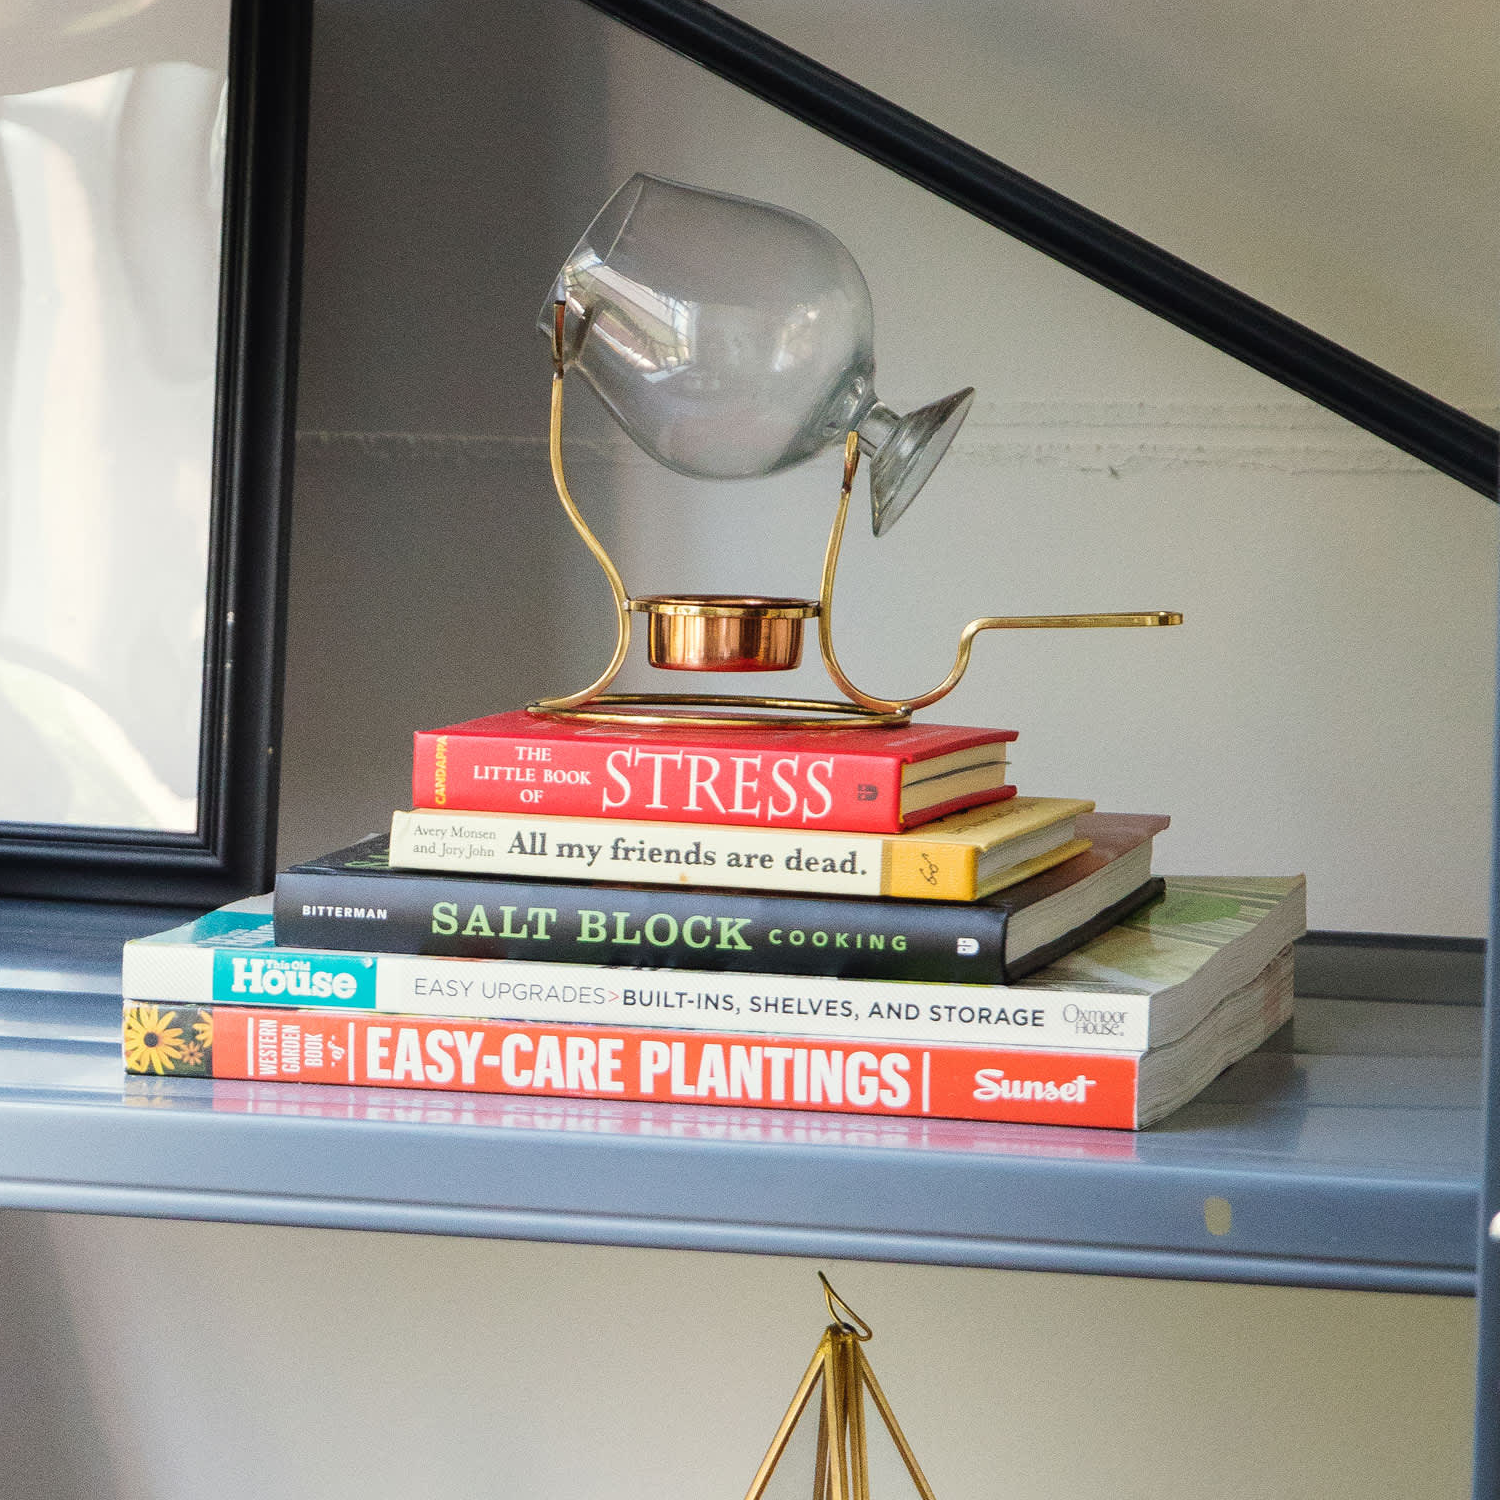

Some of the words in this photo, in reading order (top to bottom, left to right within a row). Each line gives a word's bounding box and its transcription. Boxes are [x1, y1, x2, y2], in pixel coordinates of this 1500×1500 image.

[434, 735, 448, 806] CANDAPPA
[515, 746, 552, 762] THE
[473, 765, 538, 783] LITTLE
[542, 768, 592, 786] BOOK
[519, 788, 544, 804] OF
[602, 746, 834, 823] STRESS
[412, 840, 436, 856] and
[439, 841, 465, 861] Jory
[468, 842, 496, 858] John
[414, 823, 447, 841] Avery
[450, 825, 497, 841] Monsen
[507, 831, 546, 857] All
[556, 840, 598, 867] my
[611, 836, 716, 868] friends
[726, 849, 775, 871] are
[785, 847, 868, 877] dead.
[302, 904, 388, 920] BITTERMAN
[432, 902, 558, 941] SALT
[578, 908, 753, 952] BLOCK
[768, 928, 909, 953] COOKING
[231, 958, 358, 1000] House
[266, 960, 290, 971] This
[291, 960, 312, 972] Old
[414, 977, 474, 997] EASY
[749, 995, 859, 1022] SHELVES,
[868, 1002, 921, 1023] AND
[929, 1004, 1046, 1028] STORAGE
[1062, 1003, 1128, 1024] Oxmoor
[259, 1019, 278, 1076] WESTERN
[282, 1025, 301, 1074] GARDEN
[305, 1033, 323, 1068] BOOK
[366, 1026, 625, 1094] EASY-CARE
[640, 1039, 910, 1109] PLANTINGS
[973, 1068, 1095, 1104] Sunset
